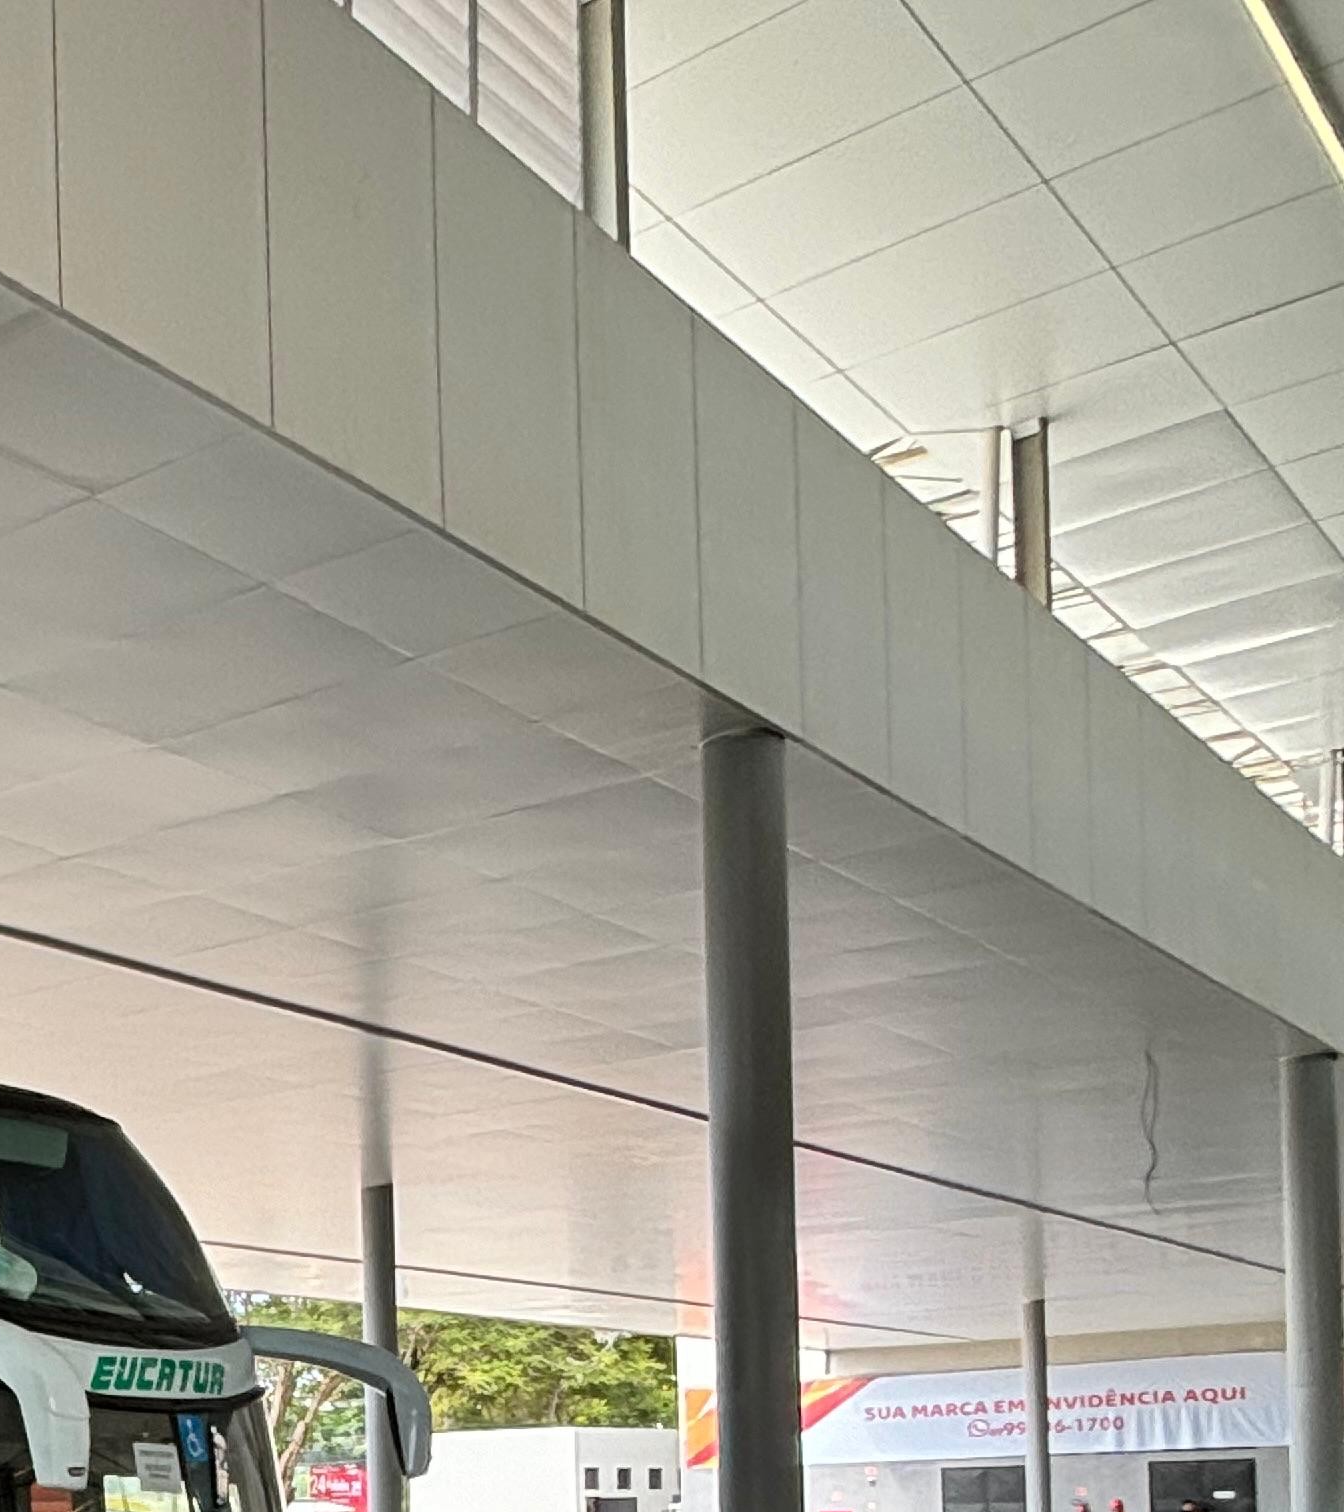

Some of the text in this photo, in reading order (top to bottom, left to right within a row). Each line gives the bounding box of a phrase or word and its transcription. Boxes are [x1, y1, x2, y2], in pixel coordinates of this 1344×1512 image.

[90, 1356, 225, 1395] EUCATUR
[864, 1406, 906, 1421] SUA
[911, 1401, 988, 1418] MARCA
[993, 1399, 1026, 1413] EM
[1182, 1386, 1246, 1405] AQUI
